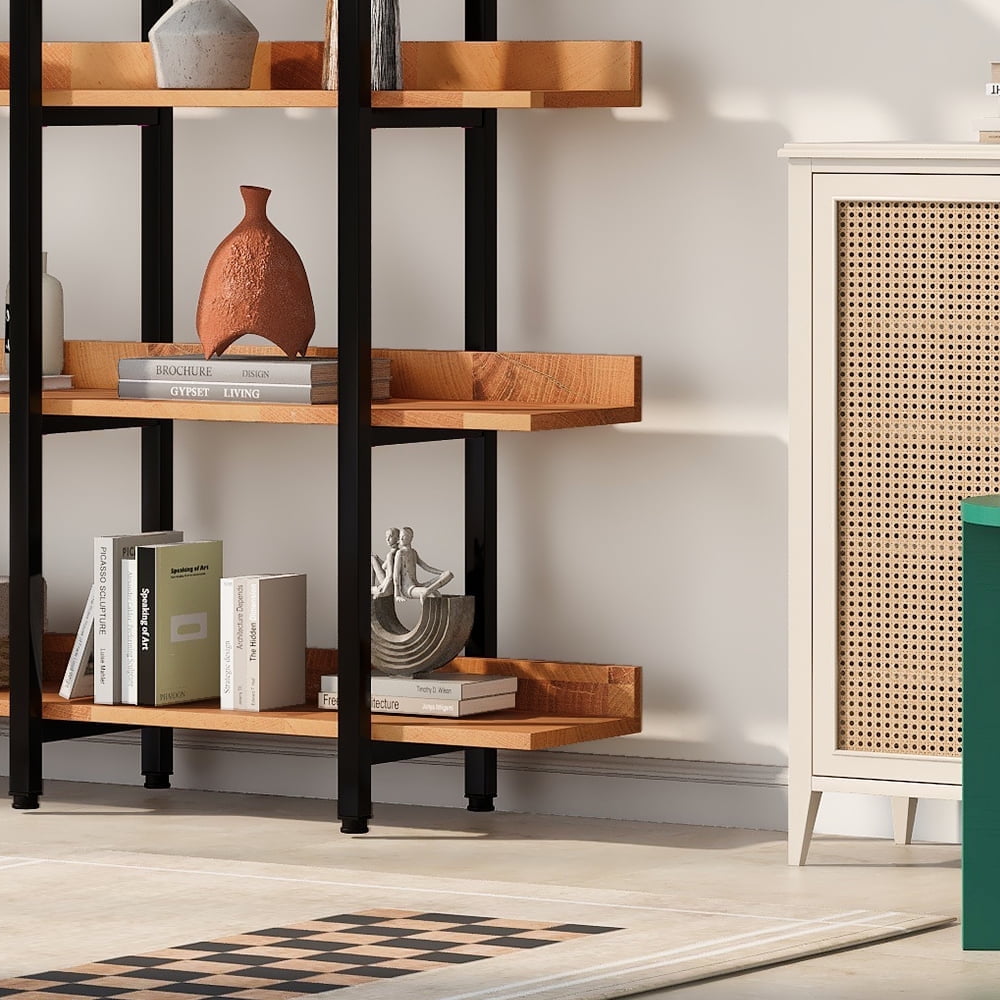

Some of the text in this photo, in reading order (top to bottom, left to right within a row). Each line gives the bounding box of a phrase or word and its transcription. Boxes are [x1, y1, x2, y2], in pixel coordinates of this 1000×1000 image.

[156, 364, 213, 377] BROCHURE
[170, 386, 260, 399] GYPSET LIVING
[99, 546, 107, 635] PICASSO SCLUPTURE
[236, 584, 245, 612] Depends
[140, 588, 150, 651] Speaking of Art
[249, 622, 257, 647] Hidden
[249, 649, 257, 661] The
